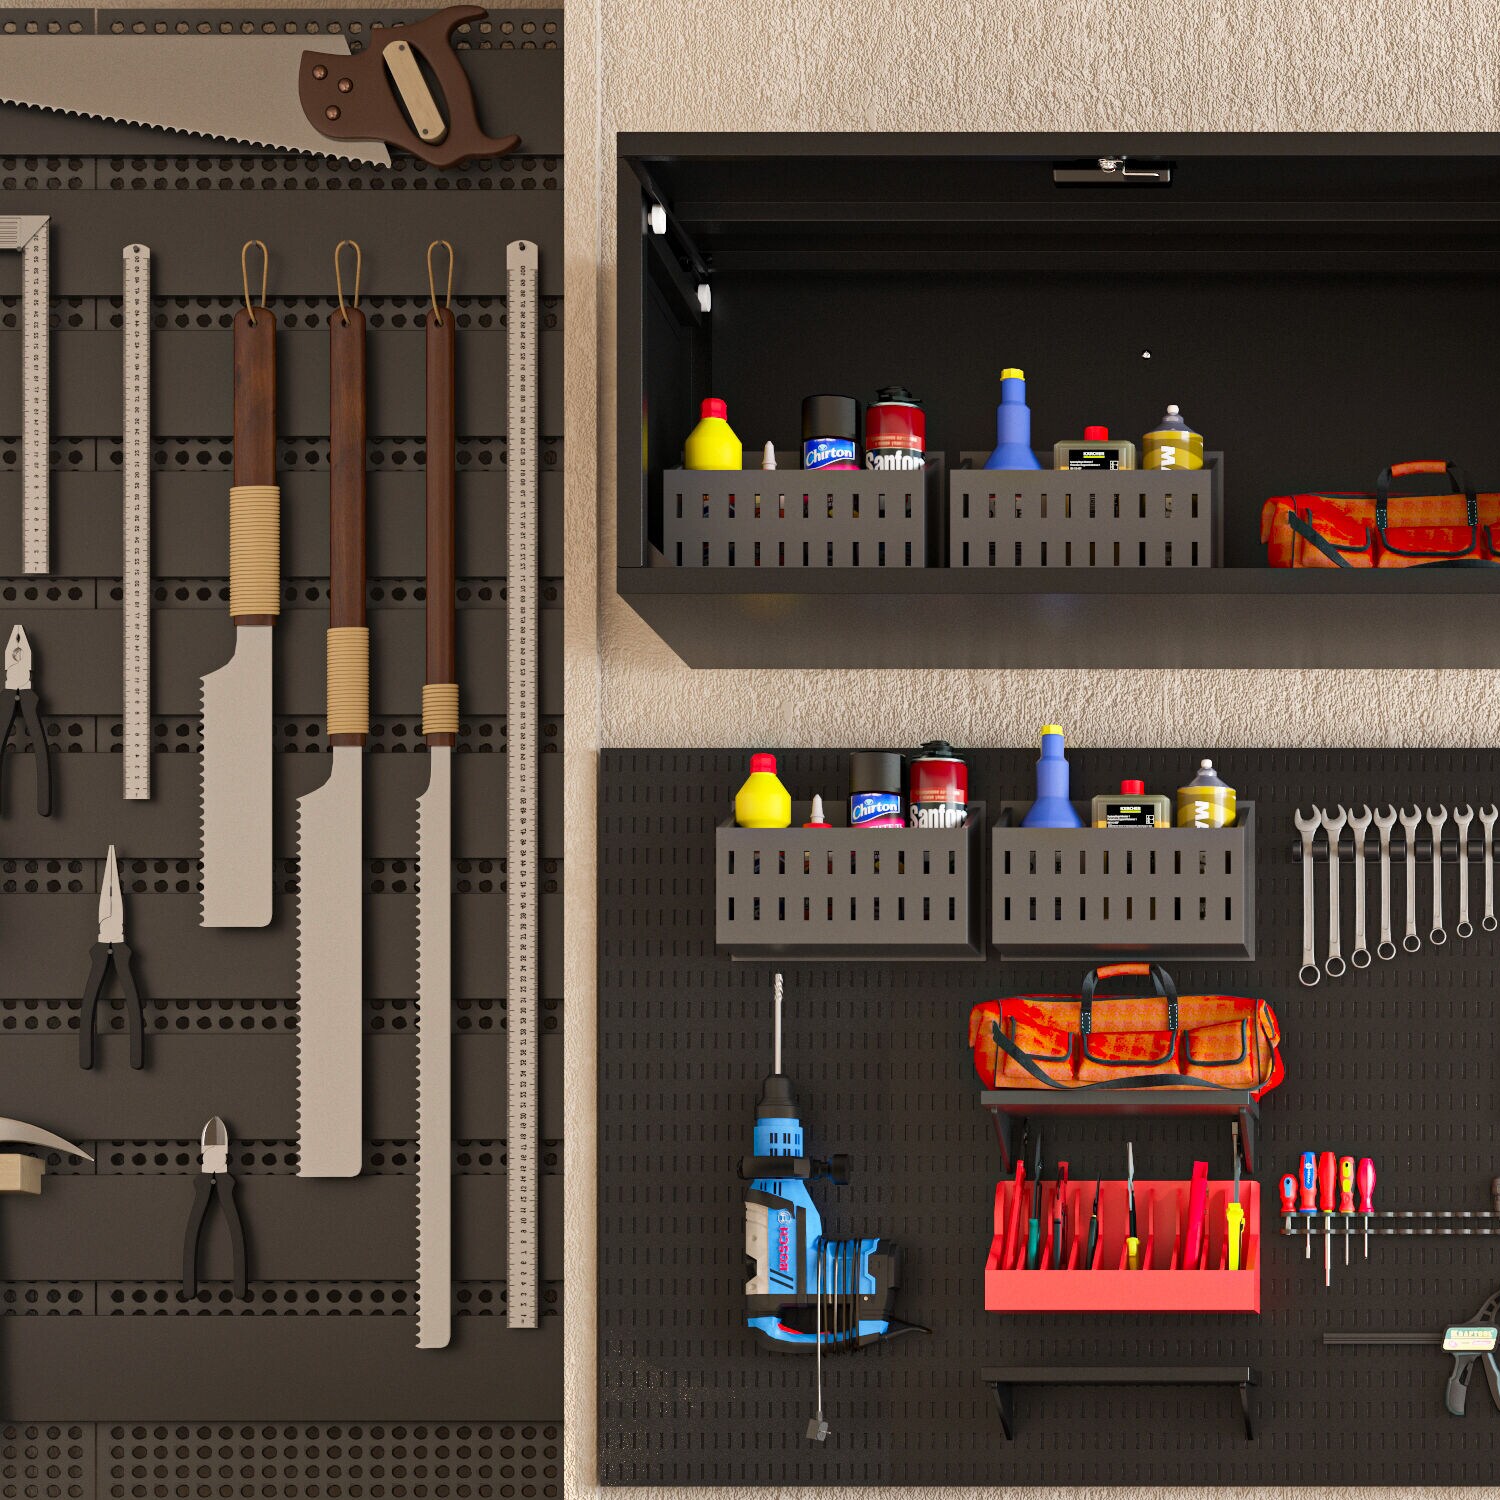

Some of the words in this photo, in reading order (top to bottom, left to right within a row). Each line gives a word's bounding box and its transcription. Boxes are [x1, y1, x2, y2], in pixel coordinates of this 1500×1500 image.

[806, 448, 852, 466] Chirton
[853, 803, 897, 820] Chirton
[779, 1227, 788, 1271] BOSCH
